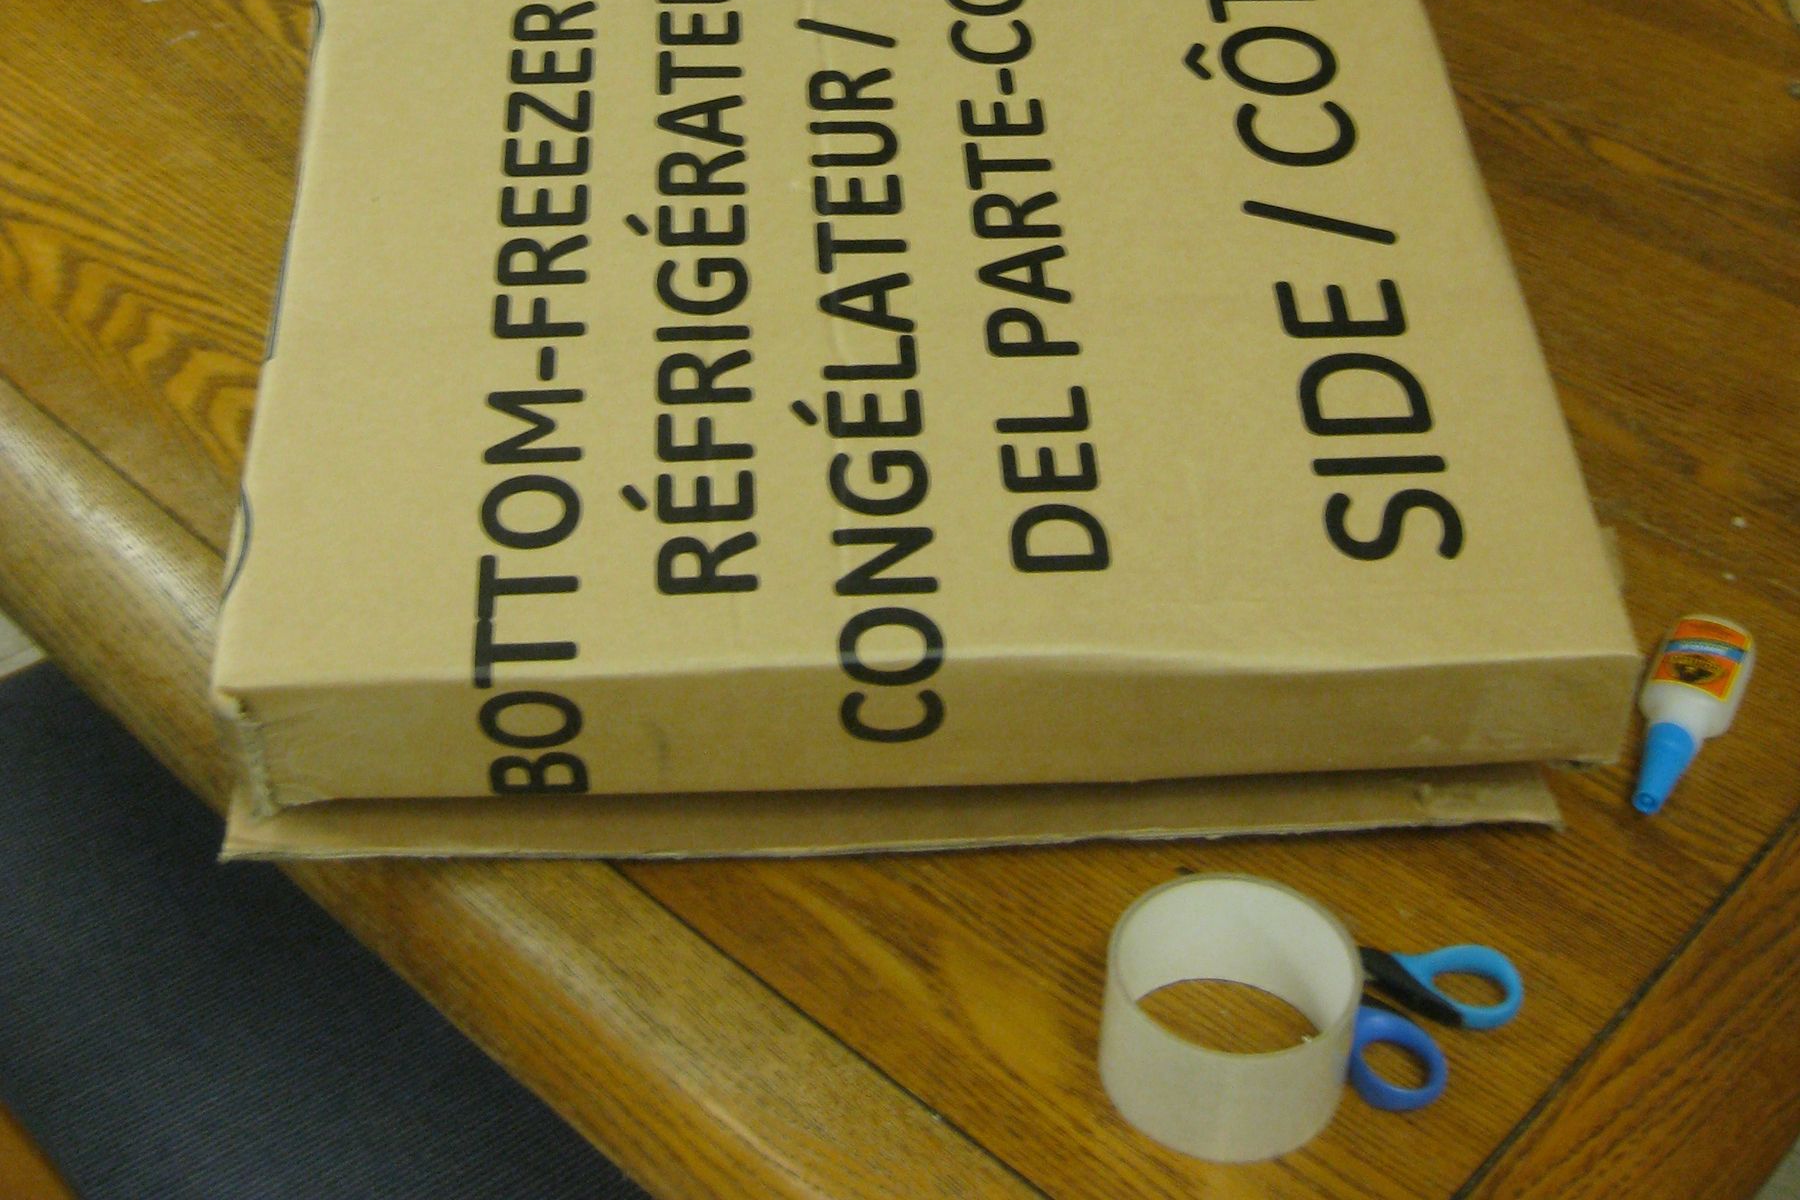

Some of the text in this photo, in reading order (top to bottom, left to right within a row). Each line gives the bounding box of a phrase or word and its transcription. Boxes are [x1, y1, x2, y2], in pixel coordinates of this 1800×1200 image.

[795, 16, 898, 50] /
[1241, 198, 1398, 247] /
[789, 66, 948, 746] CONGÉLATEUR
[994, 383, 1112, 575] DEL
[1273, 276, 1466, 563] SIDE
